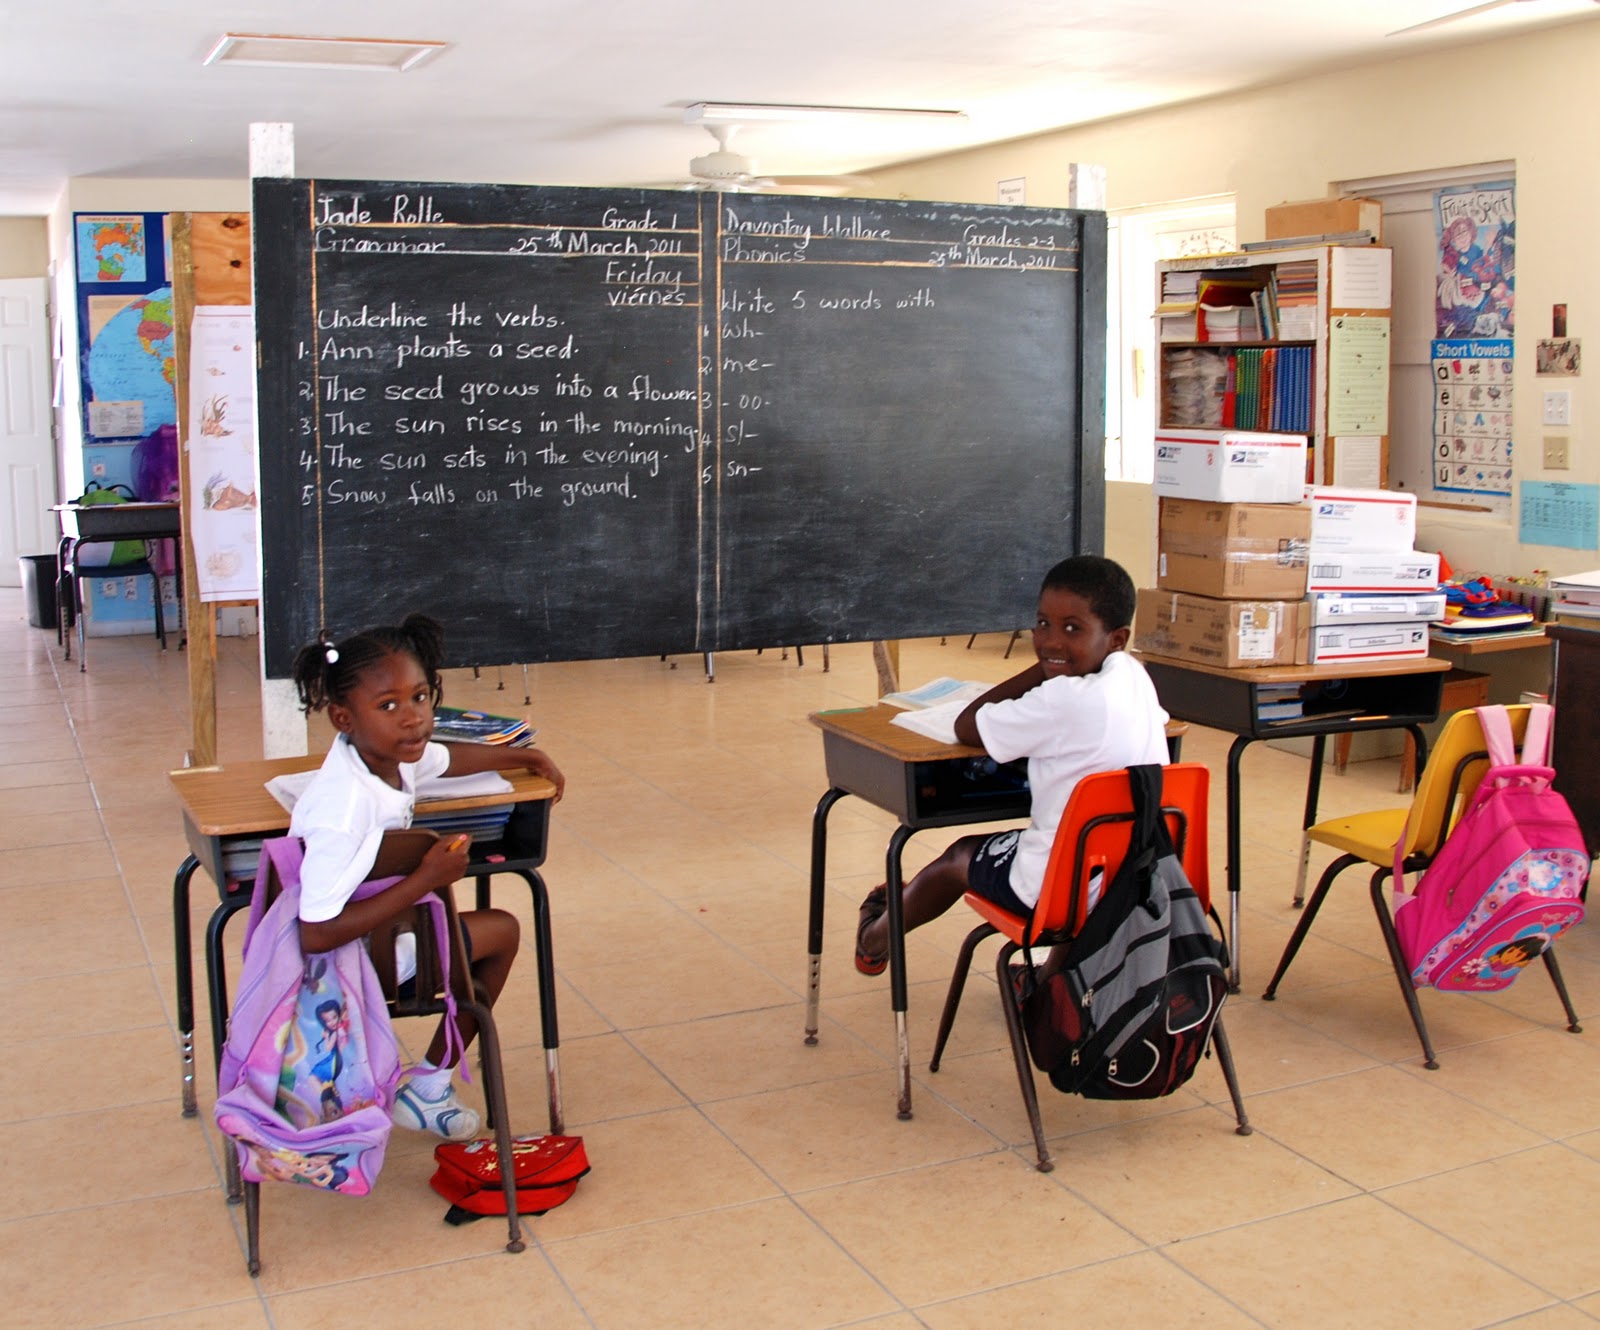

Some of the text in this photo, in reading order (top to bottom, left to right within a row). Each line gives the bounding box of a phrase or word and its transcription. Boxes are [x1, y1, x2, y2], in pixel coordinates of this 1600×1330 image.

[315, 194, 444, 224] Jade Rolle
[601, 207, 658, 230] Grade
[315, 227, 446, 252] Grammar
[723, 237, 806, 263] Phonics
[963, 224, 1021, 247] Grades
[605, 260, 682, 294] Friday
[792, 290, 805, 309] 5
[819, 290, 882, 310] words
[895, 288, 935, 309] with
[318, 301, 566, 329] Underline the verbs.
[321, 337, 373, 360] Ann
[397, 332, 471, 368] plants
[489, 344, 503, 358] a
[516, 334, 579, 359] seed.
[1437, 342, 1510, 356] Short Vowels
[319, 375, 366, 401] The
[385, 375, 444, 400] seed
[460, 382, 539, 405] grows
[555, 373, 592, 397] into
[604, 386, 618, 398] a
[628, 375, 697, 401] flower.
[325, 411, 372, 435] The
[395, 417, 445, 434] sun
[467, 409, 522, 434] rises
[540, 411, 558, 433] in
[566, 411, 601, 434] the
[614, 417, 698, 452] morning.
[324, 443, 364, 469] The
[380, 453, 426, 470] sun
[444, 445, 486, 468] sets
[505, 444, 527, 465] in
[536, 442, 569, 465] the
[582, 443, 668, 477] evening.
[327, 479, 386, 504] Snow
[408, 481, 455, 505] falls
[476, 489, 497, 502] on
[509, 476, 543, 500] the
[561, 472, 637, 506] ground.
